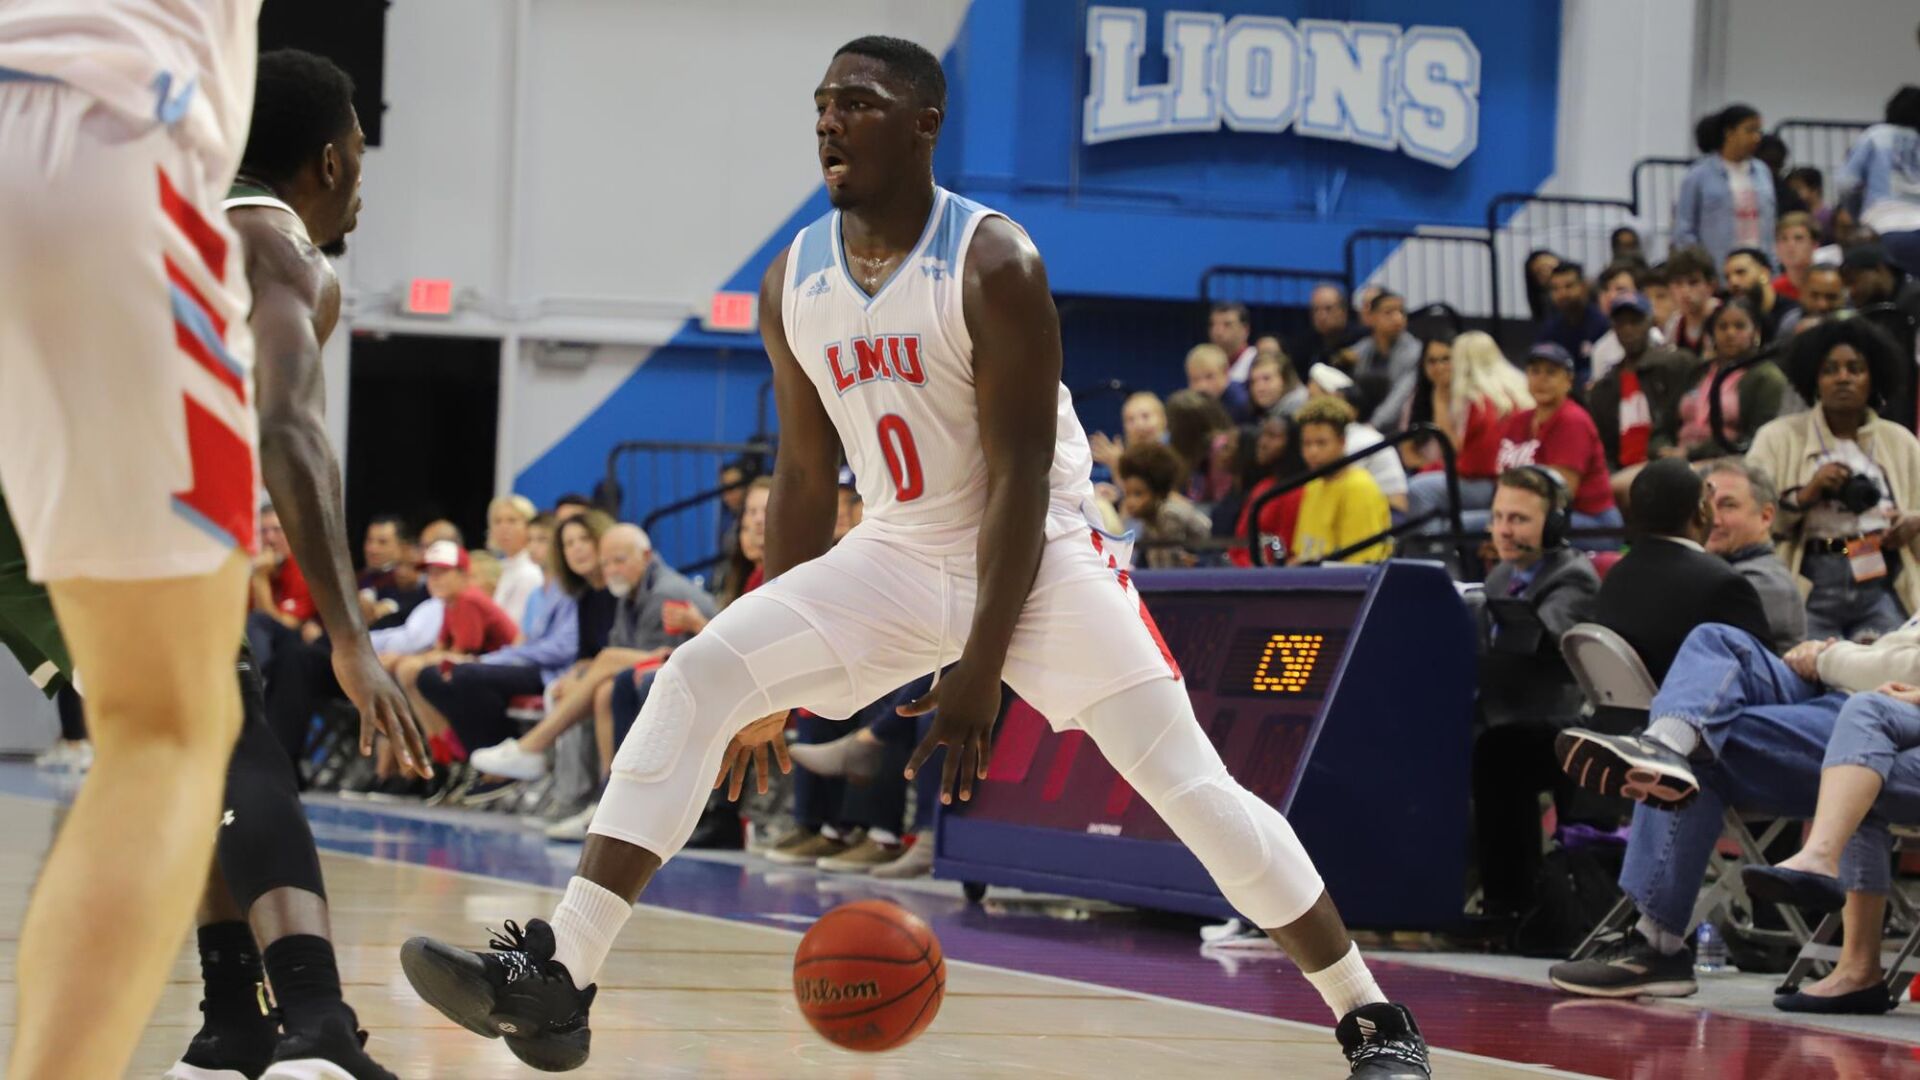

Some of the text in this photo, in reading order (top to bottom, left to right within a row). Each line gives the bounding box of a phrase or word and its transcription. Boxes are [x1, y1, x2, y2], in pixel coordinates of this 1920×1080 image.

[1083, 5, 1481, 170] LIONS
[824, 333, 928, 397] LMU
[877, 413, 924, 502] 0
[798, 977, 880, 1003] Wilson
